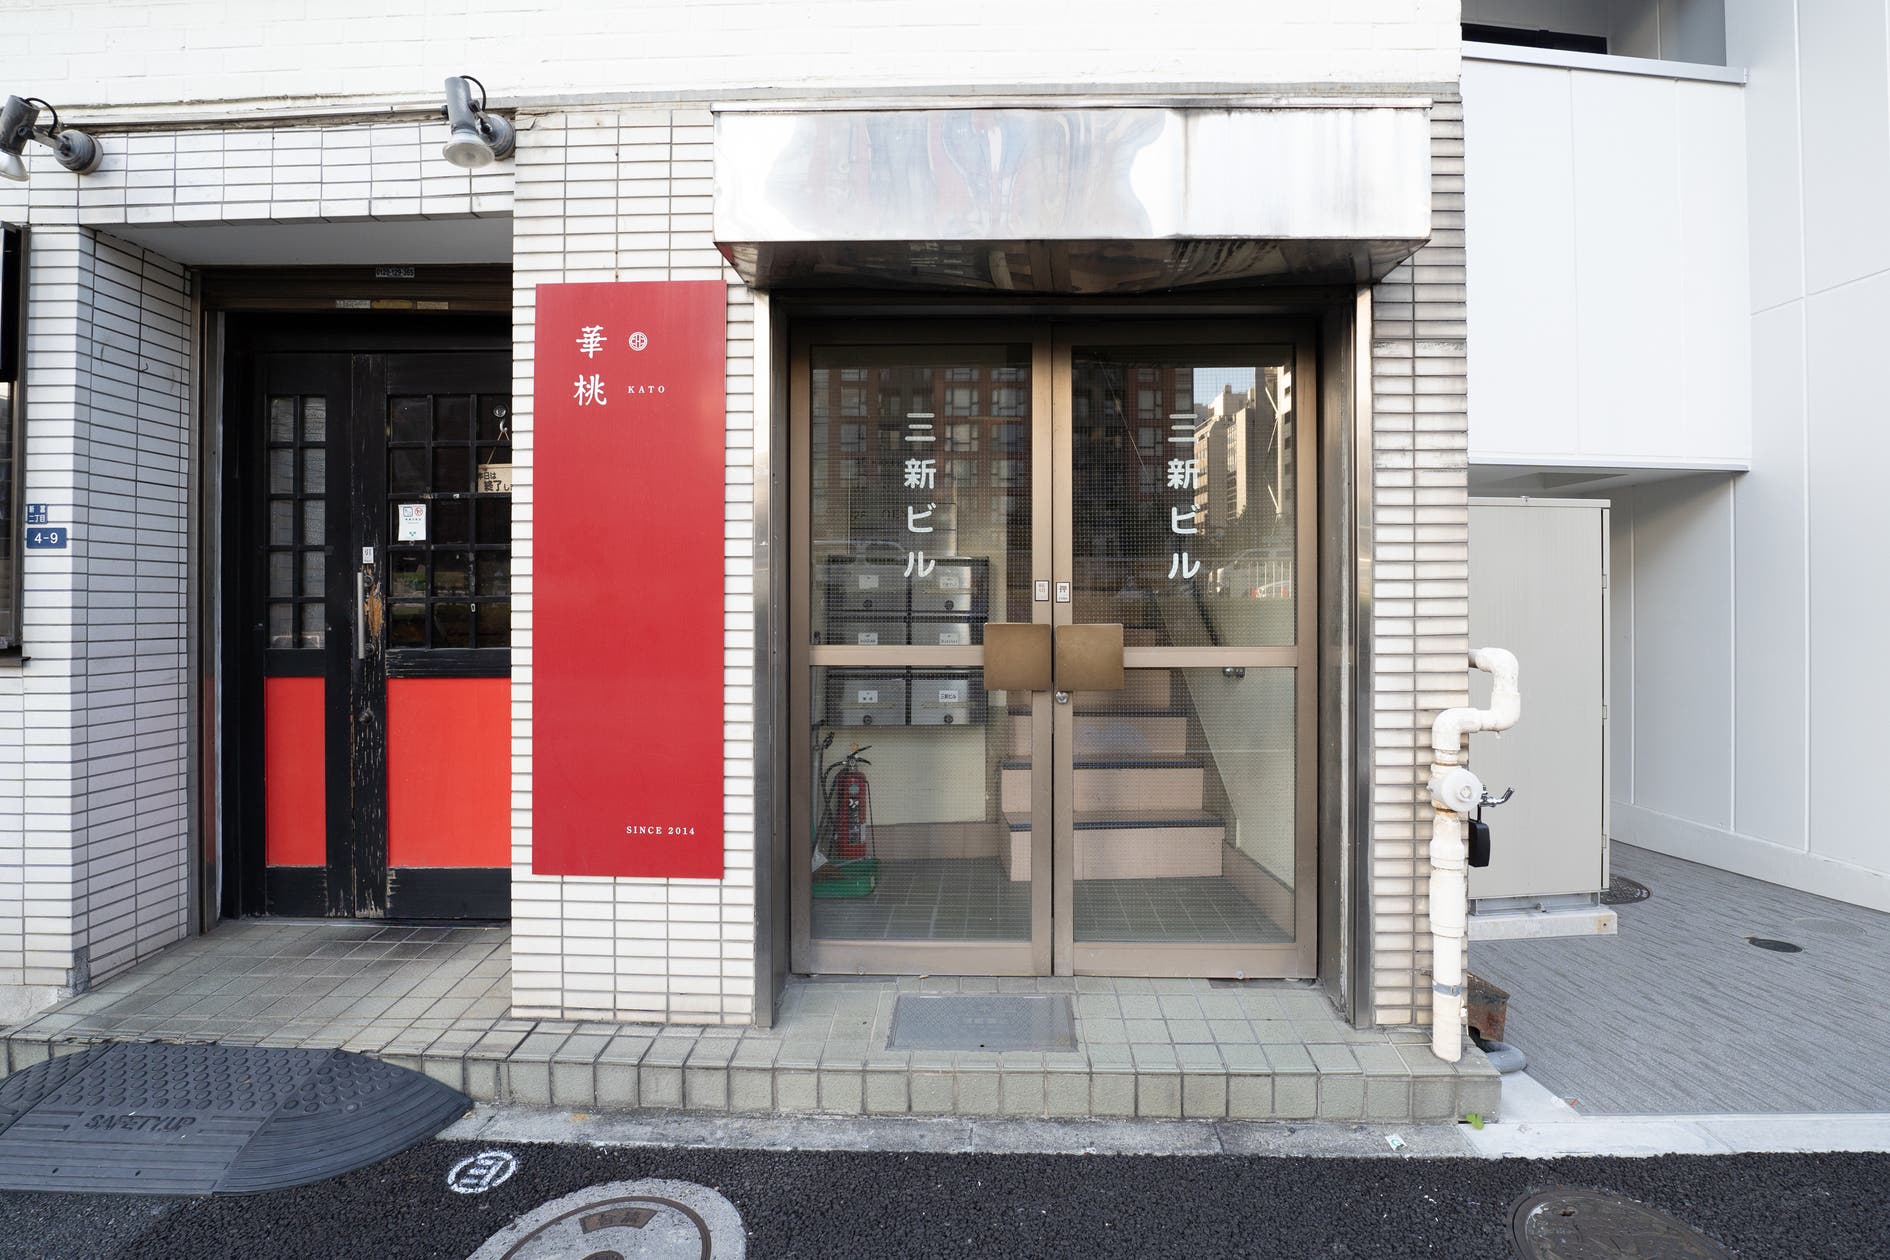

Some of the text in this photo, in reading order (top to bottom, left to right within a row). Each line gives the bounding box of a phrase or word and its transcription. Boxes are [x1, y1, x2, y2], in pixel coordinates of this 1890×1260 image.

[573, 325, 608, 406] 華桃
[627, 385, 665, 394] KATO
[904, 413, 937, 577] 三新ビル
[1167, 414, 1201, 579] 三新ビル
[28, 514, 46, 523] 二丁目
[34, 532, 59, 544] 4-9
[626, 826, 695, 836] SINCE 2014
